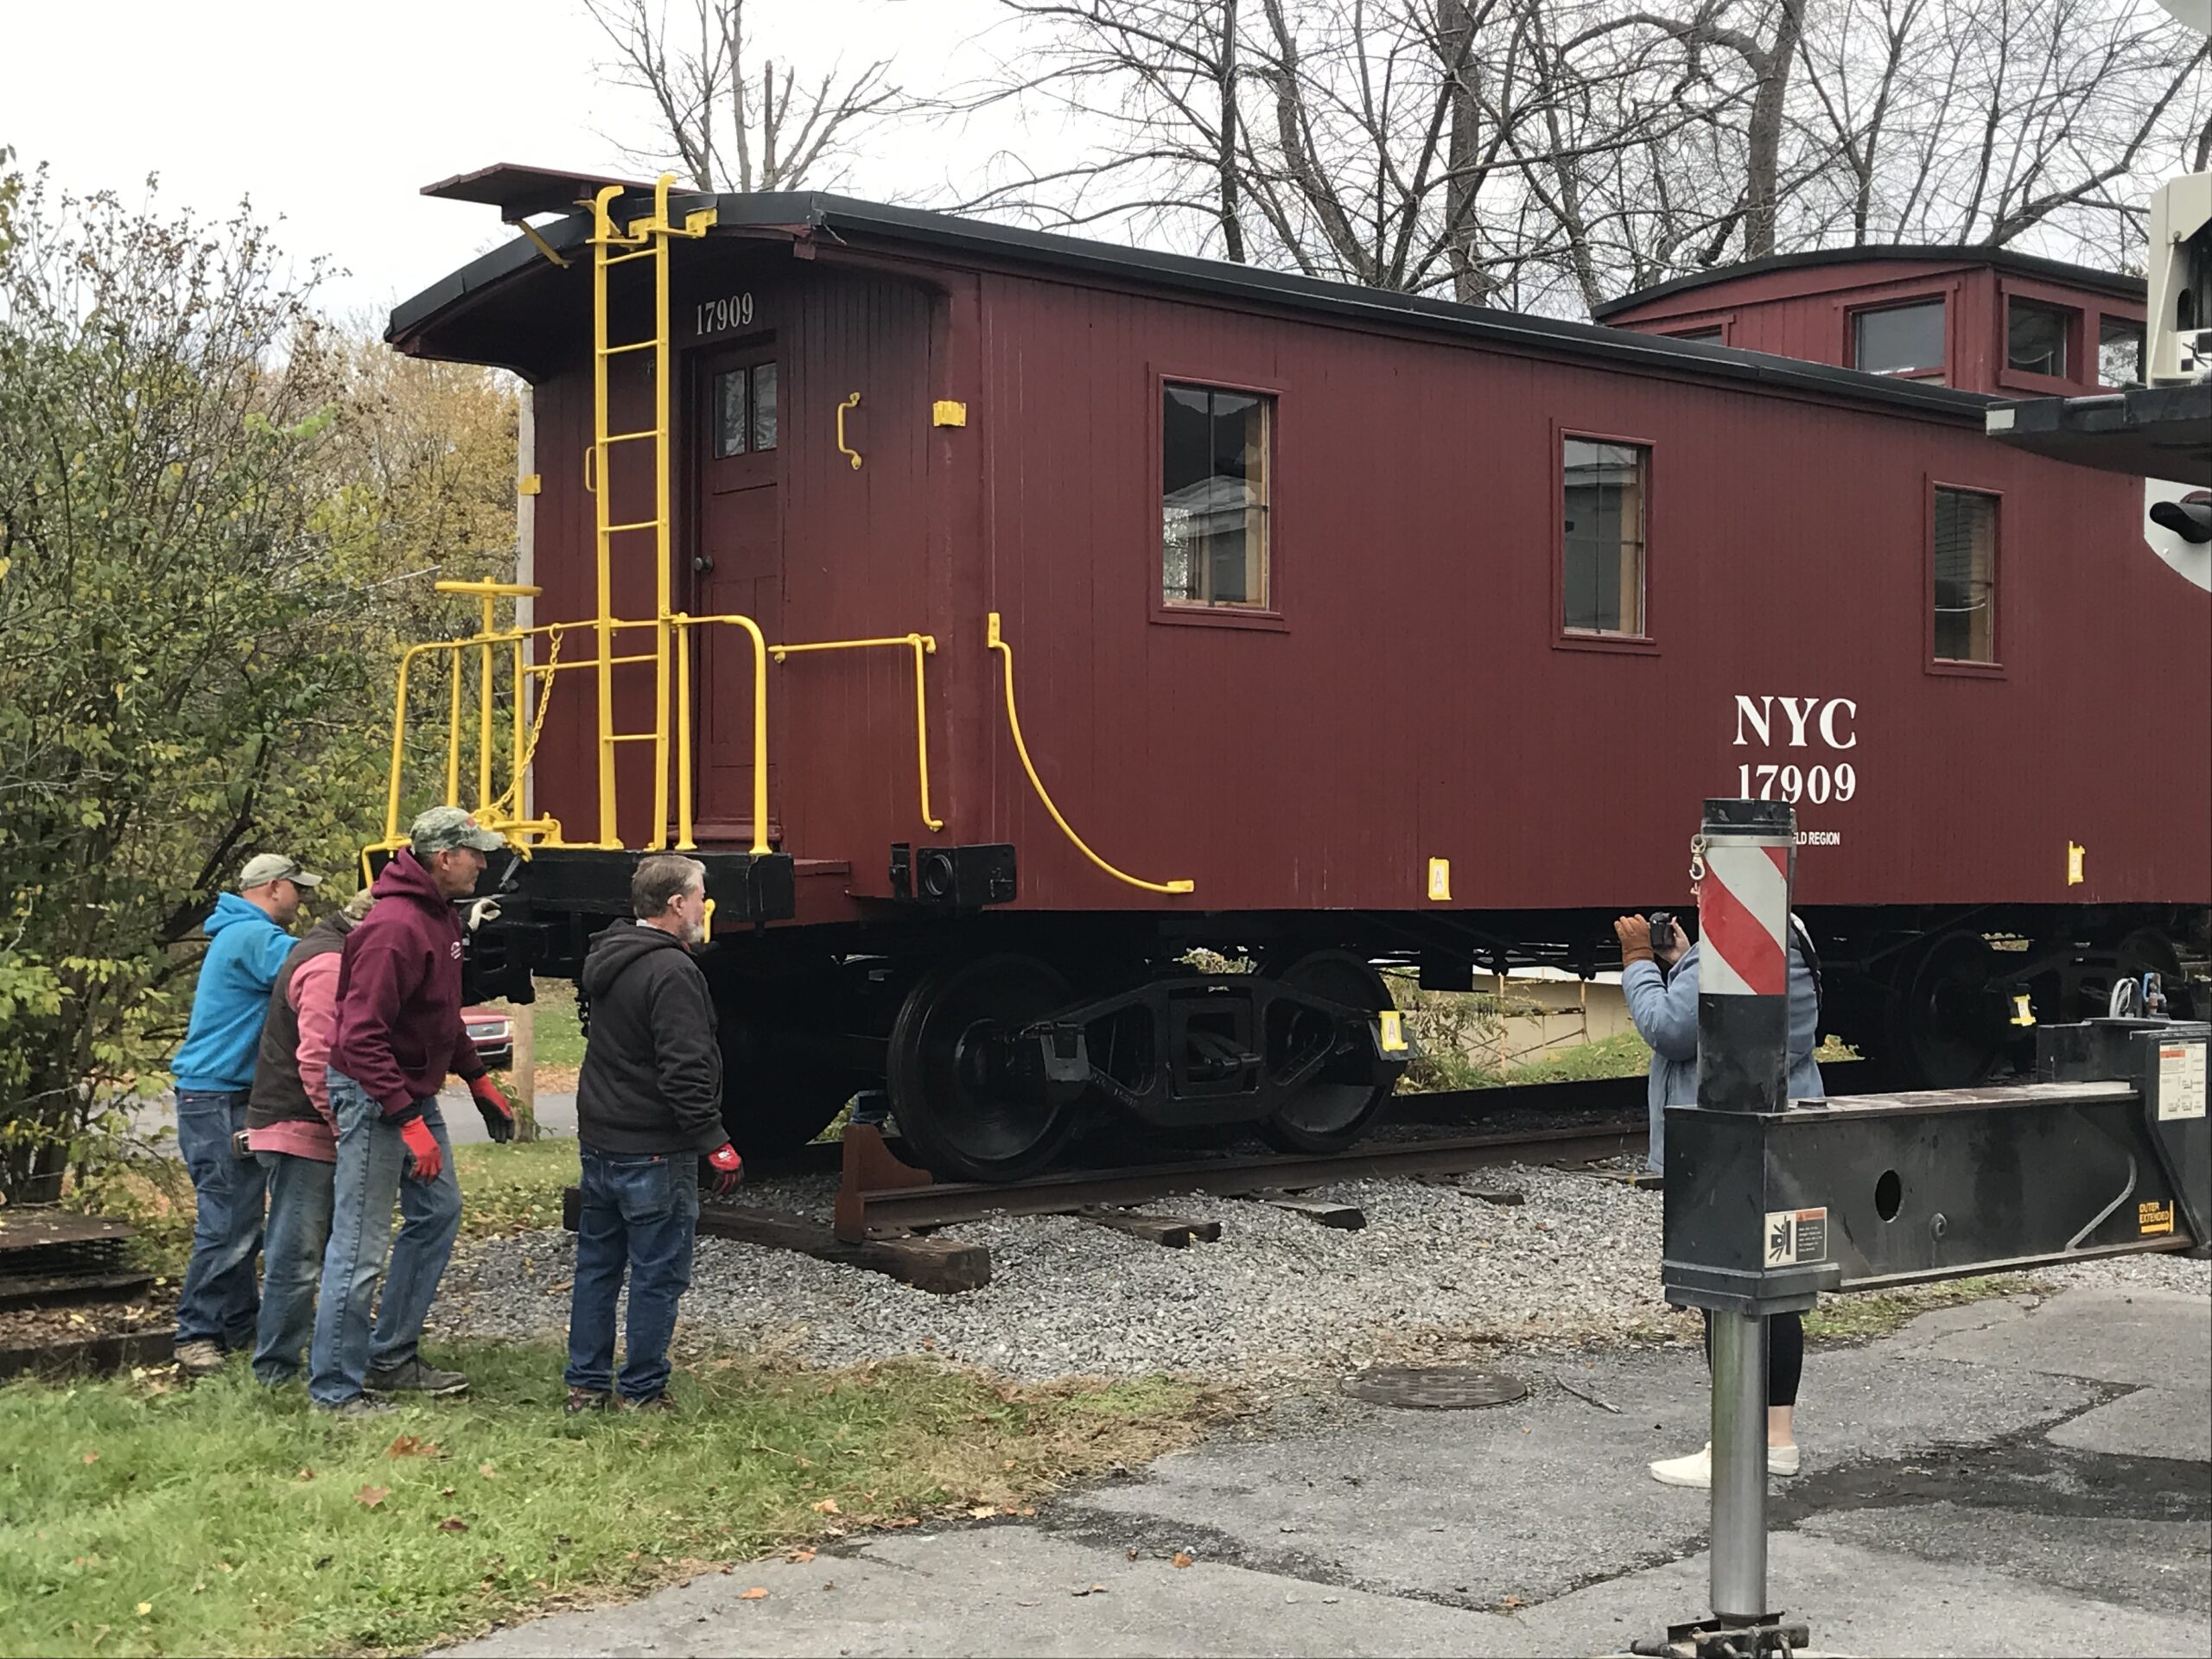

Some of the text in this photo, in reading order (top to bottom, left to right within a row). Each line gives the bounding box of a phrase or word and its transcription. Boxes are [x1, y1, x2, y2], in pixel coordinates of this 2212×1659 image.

[696, 291, 754, 335] 17909
[1732, 695, 1857, 749] NYC
[1738, 762, 1857, 805] 17909
[1808, 831, 1840, 846] REGION
[1433, 869, 1444, 888] A
[1388, 1019, 1397, 1039] A
